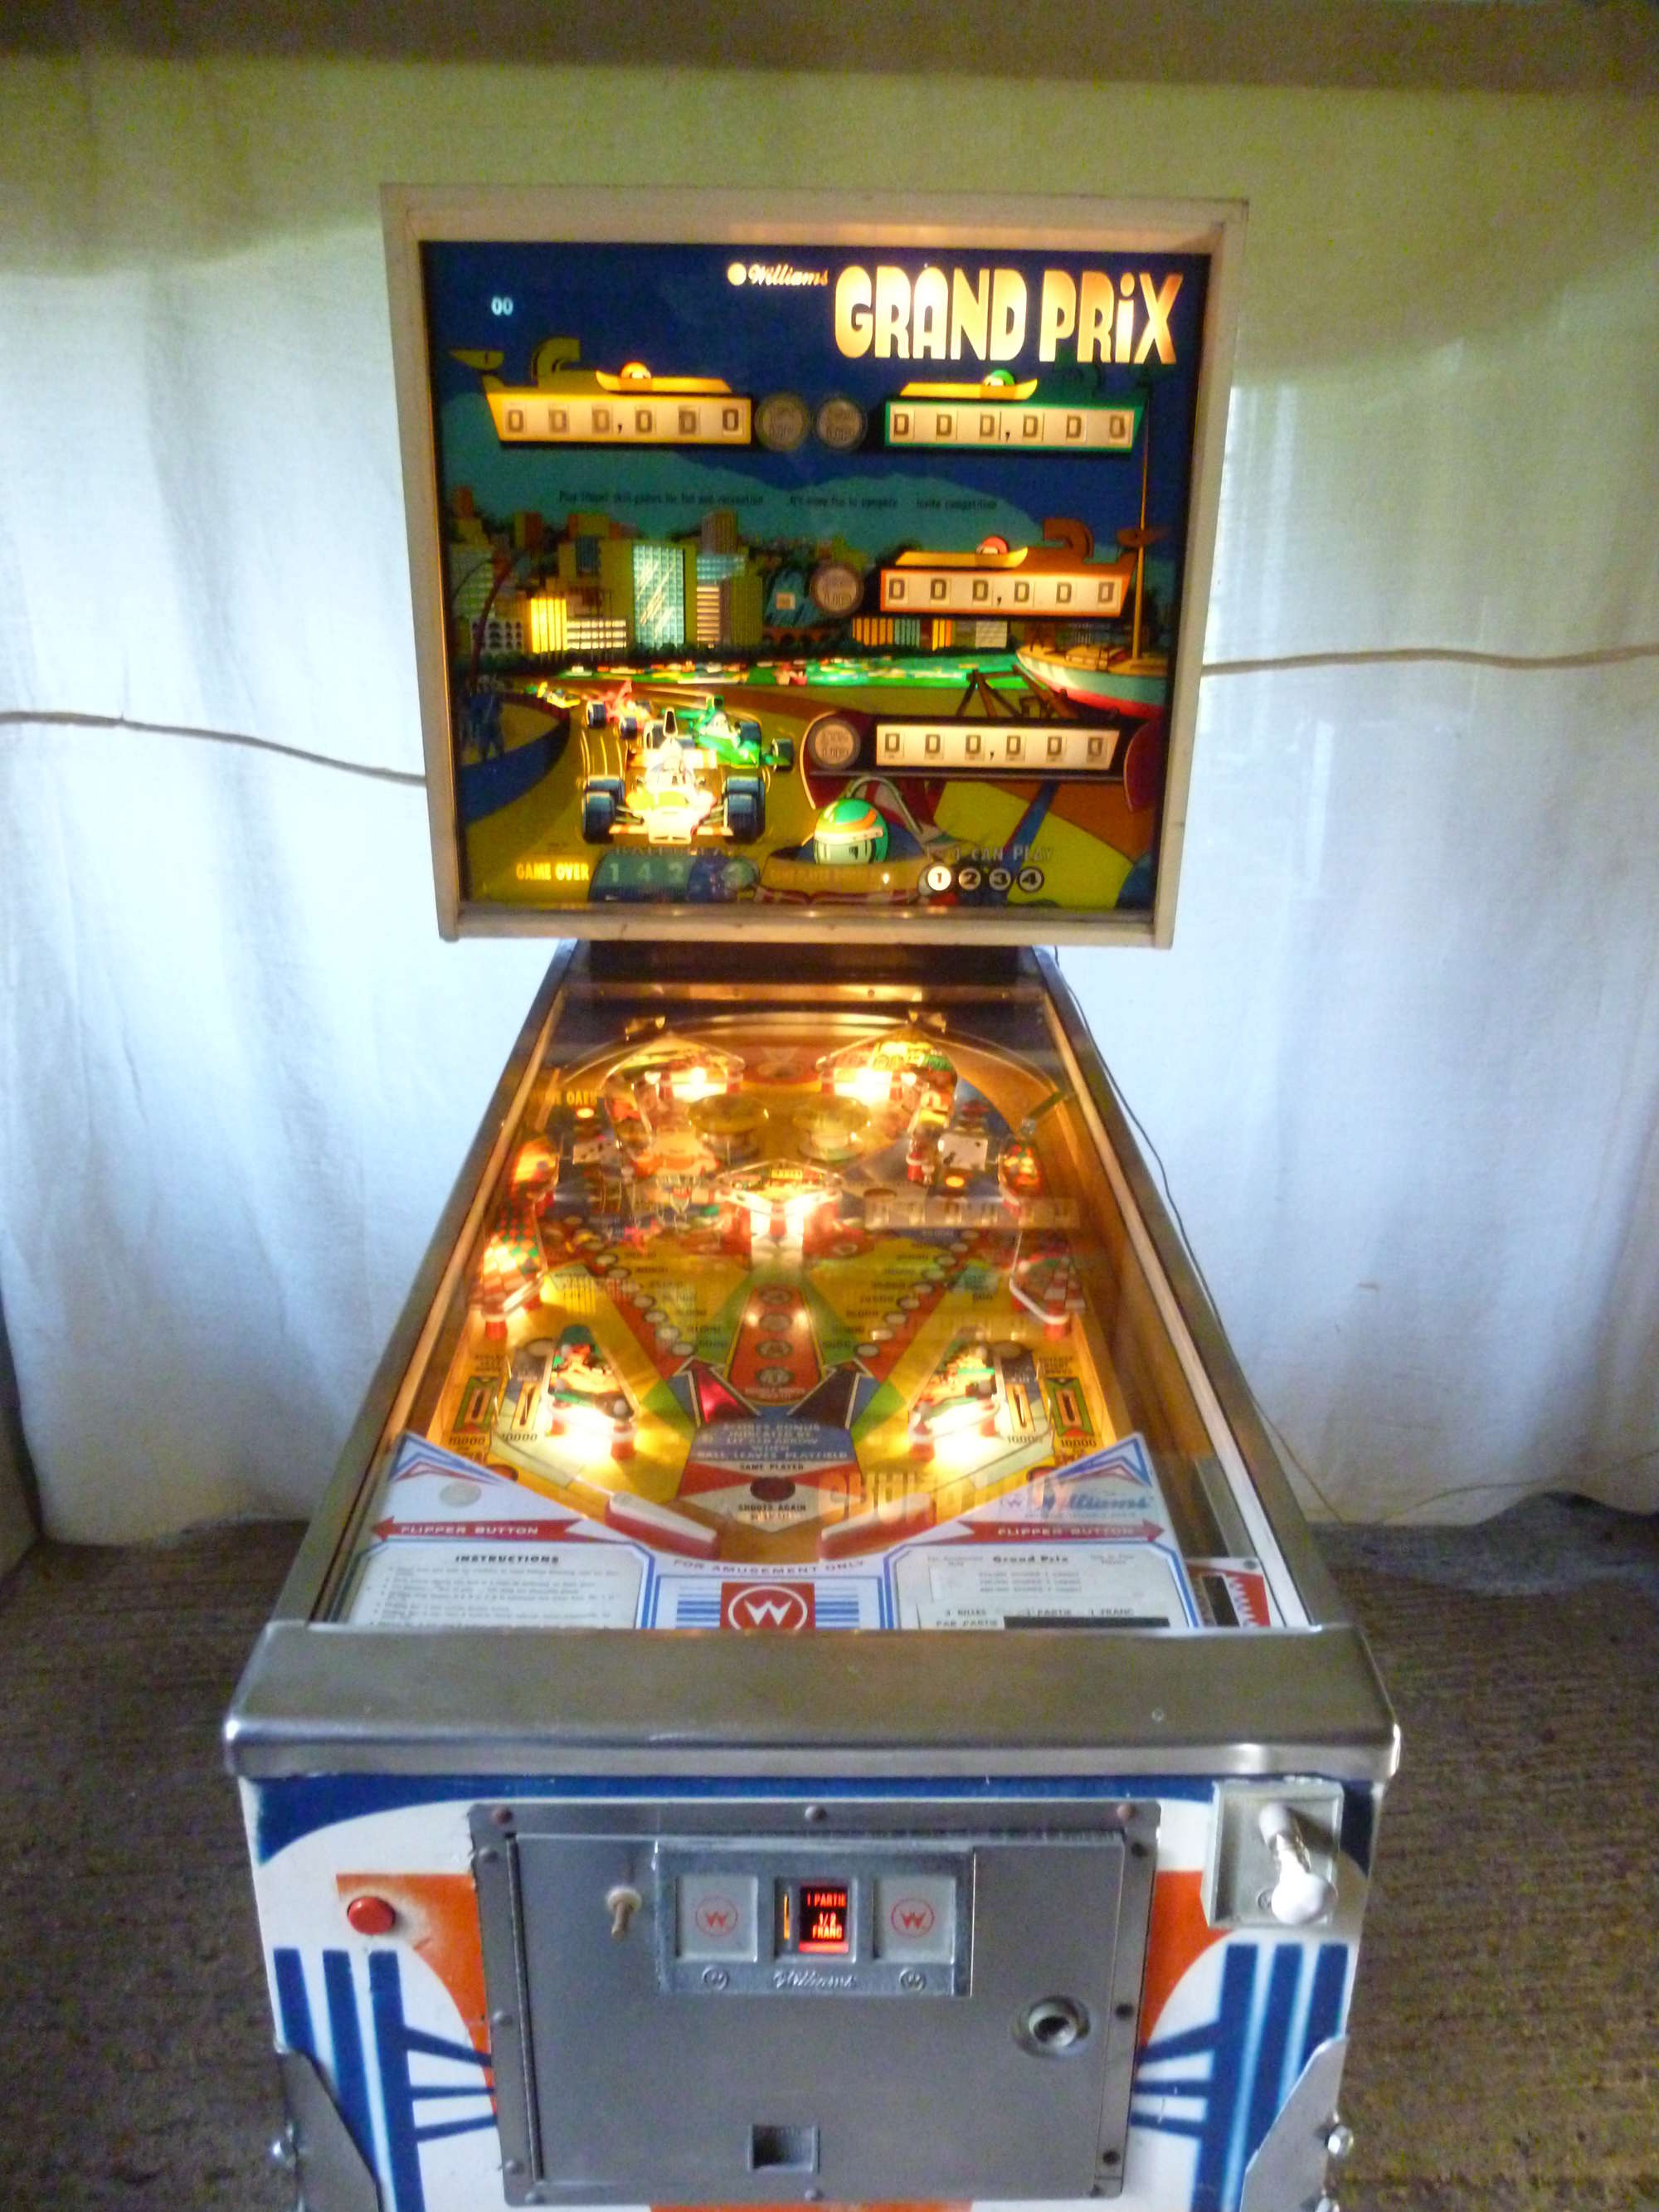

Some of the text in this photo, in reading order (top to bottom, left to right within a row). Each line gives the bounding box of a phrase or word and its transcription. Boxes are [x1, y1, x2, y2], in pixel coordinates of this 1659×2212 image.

[748, 263, 828, 286] Williams
[491, 297, 513, 316] 00
[834, 265, 1027, 362] GRAND
[516, 863, 590, 881] GAME OVER
[778, 1504, 806, 1512] AGAIN
[401, 1526, 538, 1534] FLIPPER BUTTON
[998, 1527, 1063, 1535] FLIPPER
[455, 1555, 559, 1564] INSTRUCTIONS
[674, 1559, 864, 1574] FOR AMUSEMENT ONLY
[993, 1555, 1035, 1563] Grand
[1041, 1555, 1068, 1563] Prix
[812, 1924, 842, 1939] FRANC
